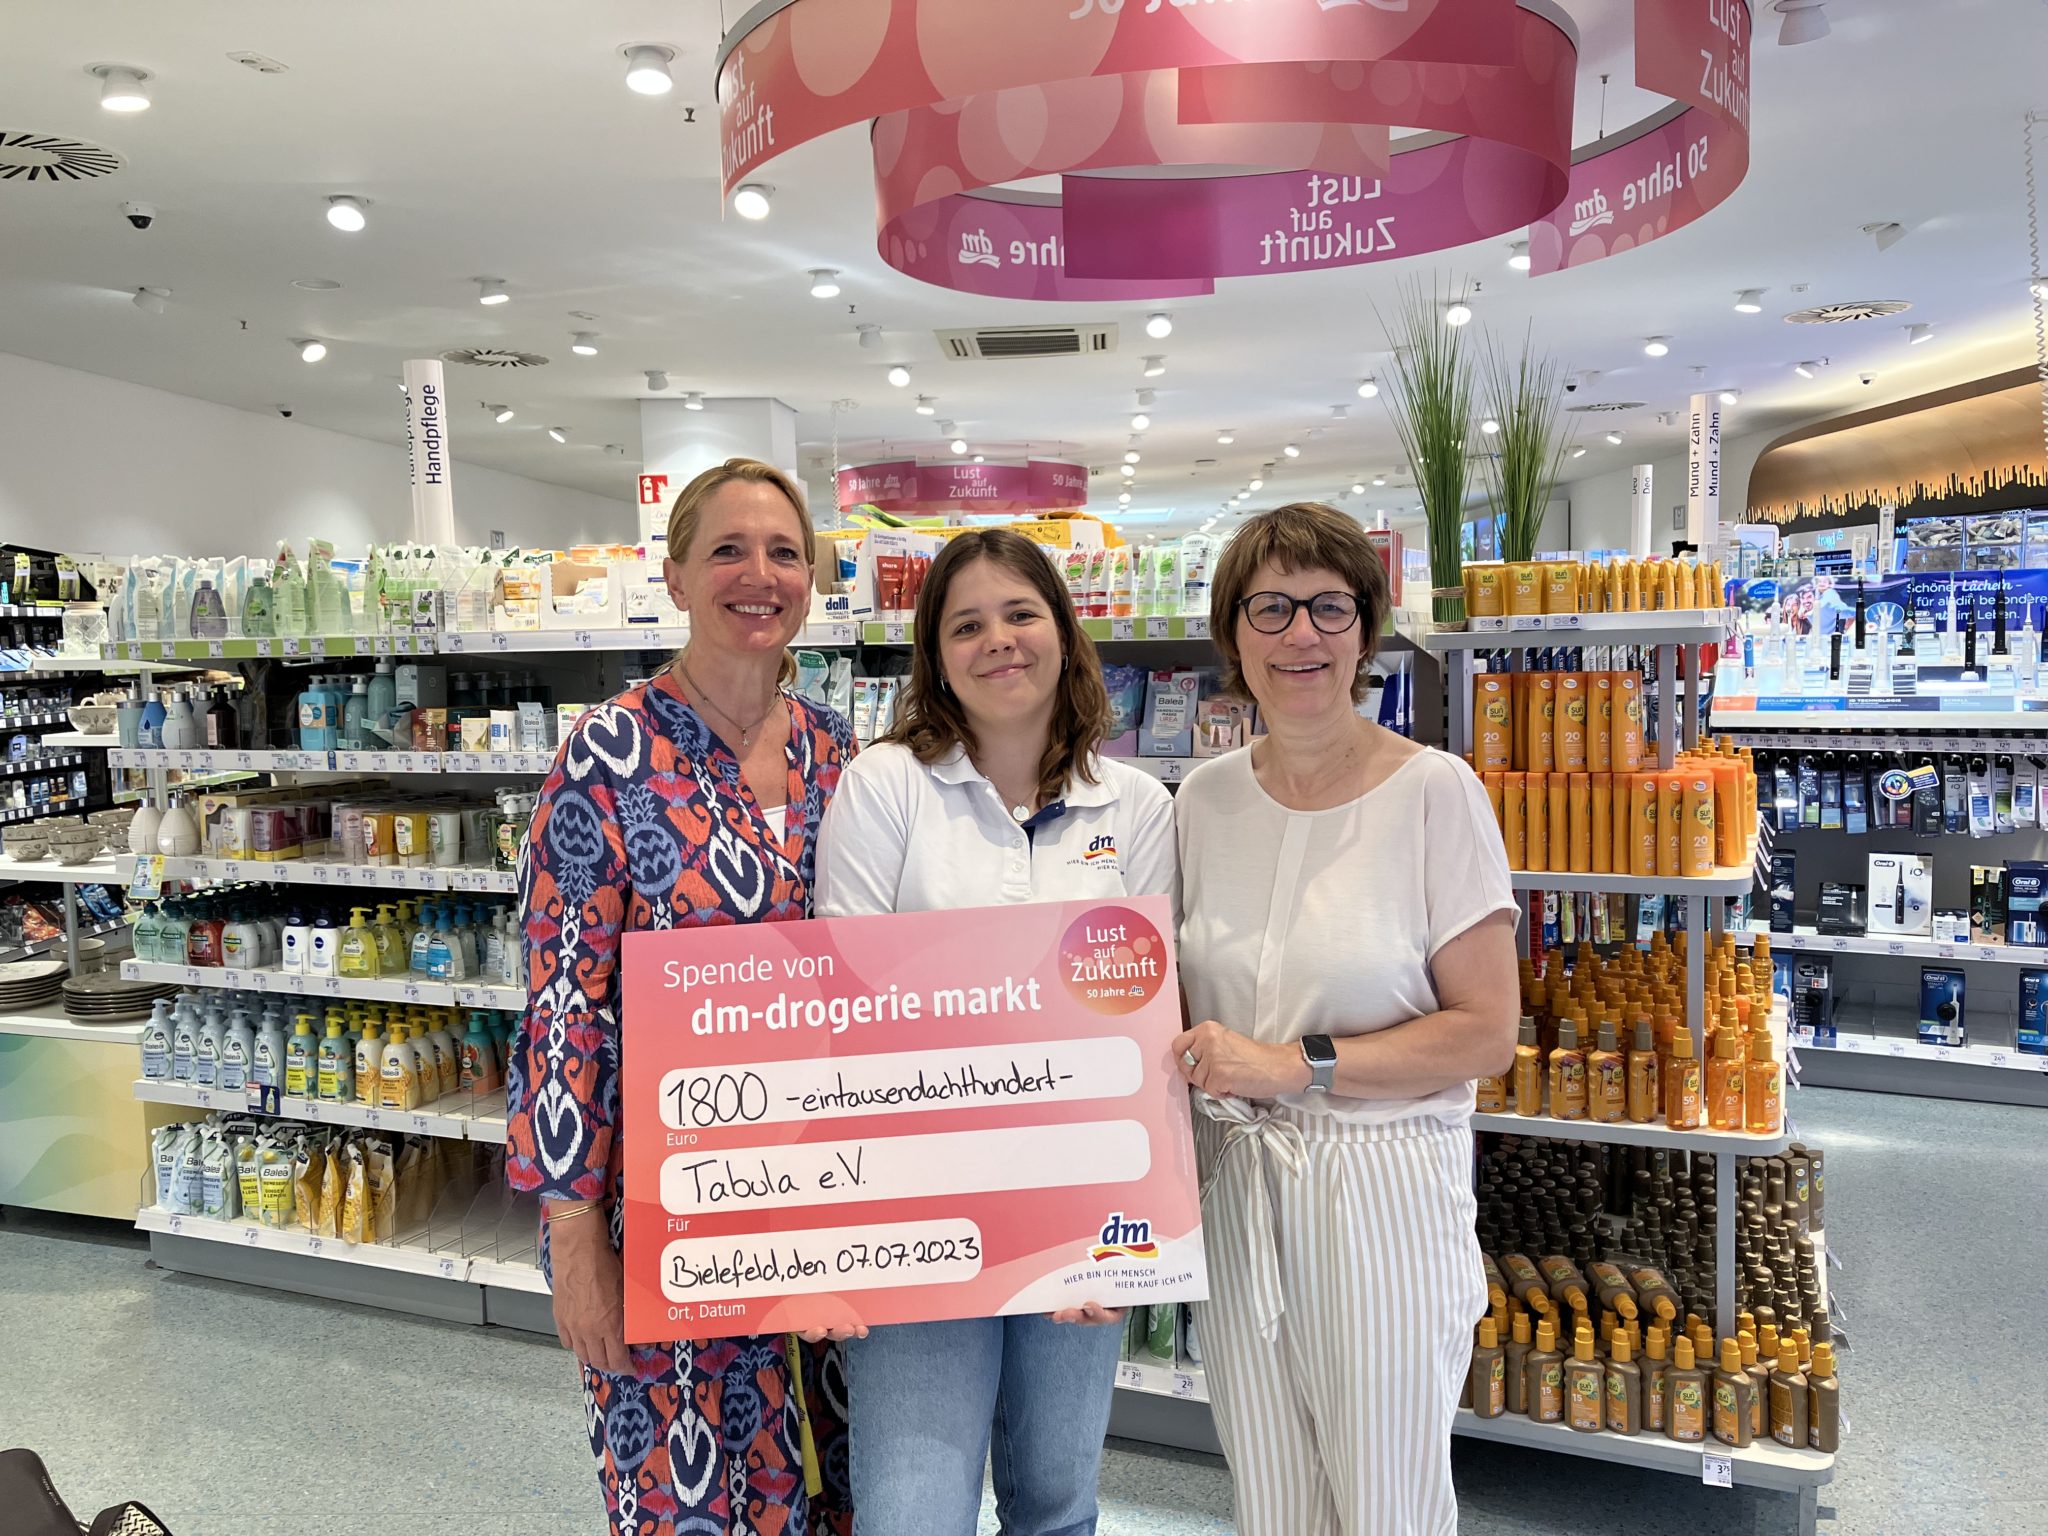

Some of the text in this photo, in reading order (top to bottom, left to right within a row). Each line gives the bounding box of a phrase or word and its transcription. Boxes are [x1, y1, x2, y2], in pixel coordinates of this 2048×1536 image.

[736, 80, 755, 127] auf
[421, 384, 442, 484] Handpflege
[1690, 413, 1700, 445] Zahn
[1709, 412, 1720, 444] Zahn
[953, 467, 981, 479] Lust
[1690, 461, 1700, 497] Mund
[1709, 461, 1718, 496] Mund
[849, 479, 857, 490] 50
[858, 477, 881, 490] Jahre
[972, 477, 988, 487] auf
[1052, 474, 1083, 489] 50 Jahre
[1642, 476, 1651, 494] Deo
[949, 485, 999, 498] Zukunft
[1478, 588, 1492, 596] 30
[1516, 585, 1531, 594] 30
[1551, 584, 1565, 593] 30
[631, 592, 648, 601] Dove
[1917, 596, 1935, 606] für
[825, 597, 849, 611] dalli
[1158, 696, 1184, 706] Balea
[1490, 706, 1503, 714] sun
[1571, 705, 1584, 714] sun
[1483, 732, 1500, 742] 20
[1565, 732, 1581, 742] 20
[1089, 834, 1115, 852] dm
[1694, 836, 1709, 847] 20
[1086, 924, 1126, 943] Lust
[1093, 945, 1117, 959] auf
[663, 954, 834, 993] Spende von
[1071, 956, 1158, 982] Zukunft
[1087, 987, 1099, 998] 50
[1101, 986, 1126, 998] Jahre
[691, 976, 1042, 1036] dm-drogerie markt
[1478, 1078, 1492, 1087] 20
[1566, 1083, 1580, 1093] 20
[1606, 1087, 1620, 1096] 20
[1683, 1095, 1696, 1105] 50
[1726, 1095, 1739, 1105] 20
[1764, 1098, 1777, 1108] 20
[666, 1133, 698, 1147] Euro
[263, 1166, 289, 1177] Balea
[682, 1160, 801, 1204] Tabula
[667, 1217, 691, 1233] Für
[1102, 1215, 1149, 1246] dm
[1064, 1268, 1156, 1286] HIER BIN ICH MENSCH
[1115, 1271, 1193, 1289] HIER KAUF ICH EIN
[667, 1303, 746, 1322] Ort, Datum
[1541, 1386, 1552, 1396] 15
[1579, 1381, 1592, 1389] sun
[1572, 1393, 1583, 1402] 15
[1682, 1391, 1695, 1399] sun
[1675, 1404, 1686, 1413] 15
